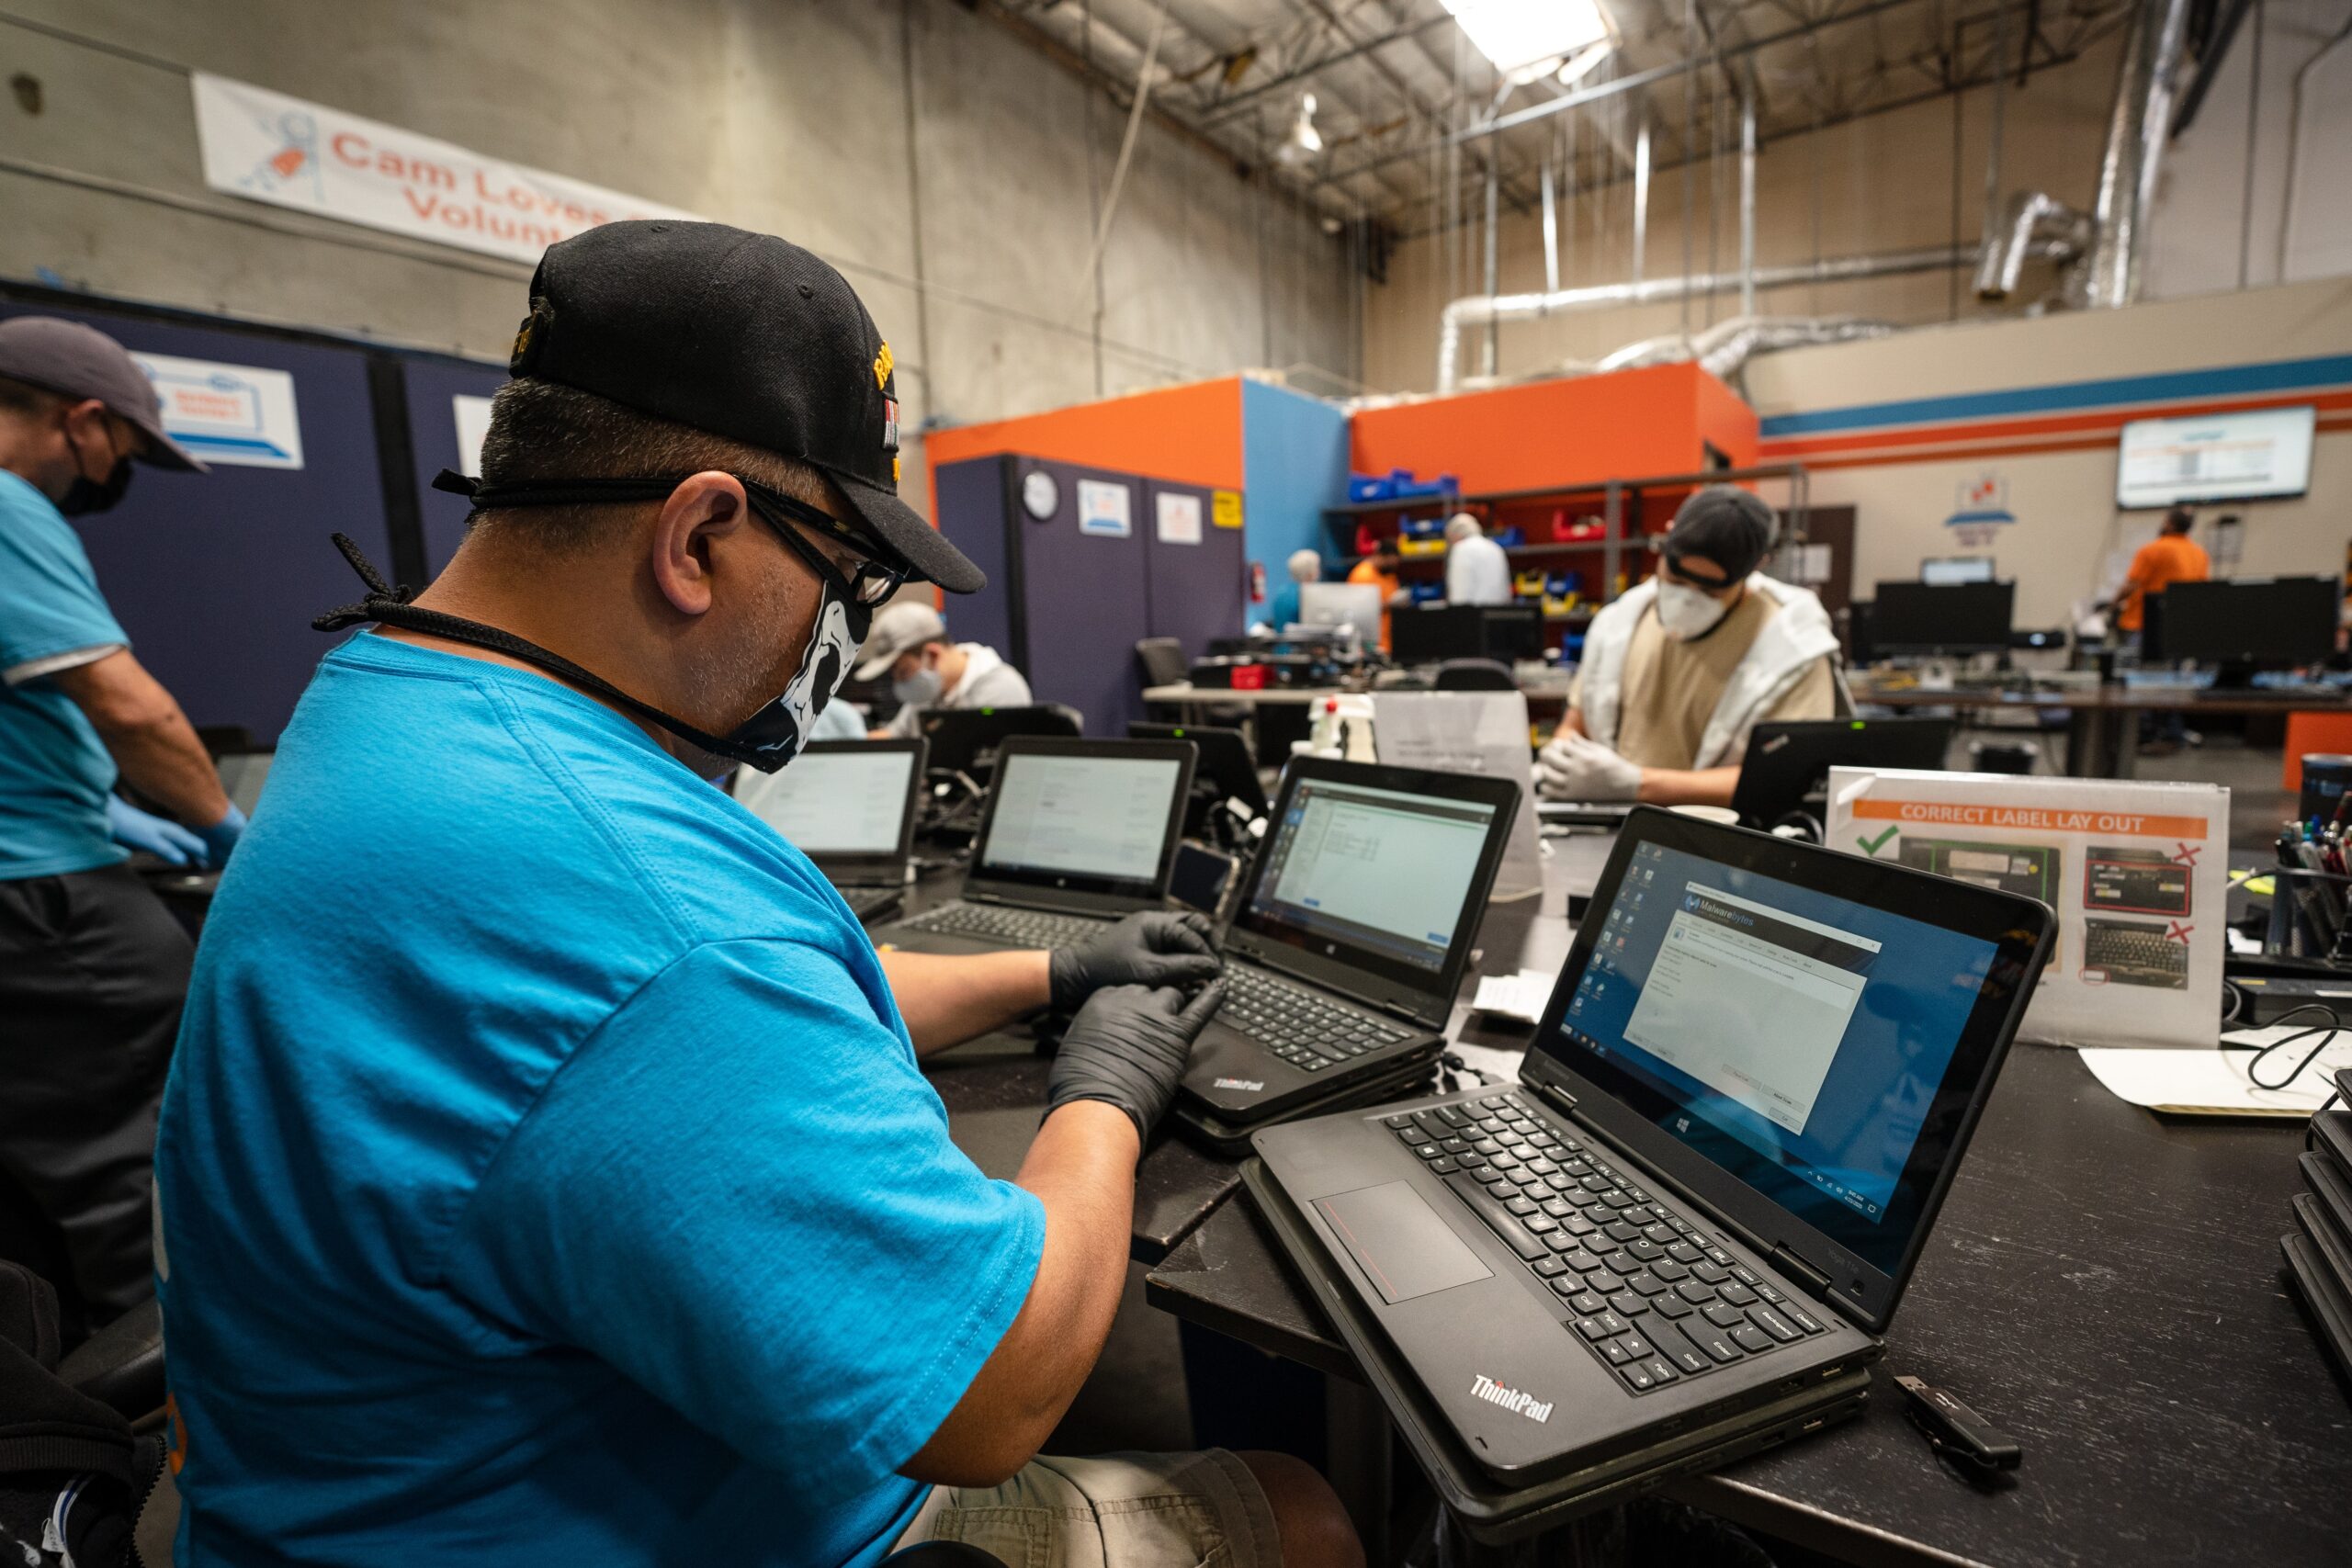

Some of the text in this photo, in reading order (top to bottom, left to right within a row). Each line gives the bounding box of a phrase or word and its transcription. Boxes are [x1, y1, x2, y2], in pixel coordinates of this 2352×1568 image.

[332, 131, 610, 228] Cam Loves
[401, 186, 563, 254] Volunt
[1901, 804, 2144, 832] CORRECT LABEL LAY OUT
[1700, 899, 1755, 927] Malwarebytes
[1737, 1268, 1755, 1281] Home
[1580, 1295, 1594, 1306] Ctrl
[1762, 1288, 1777, 1300] End
[1761, 1311, 1794, 1337] Backspace
[1796, 1313, 1816, 1329] Delete
[1713, 1341, 1732, 1357] Enter
[1683, 1353, 1701, 1368] Shift
[1470, 1373, 1555, 1425] ThinkPad
